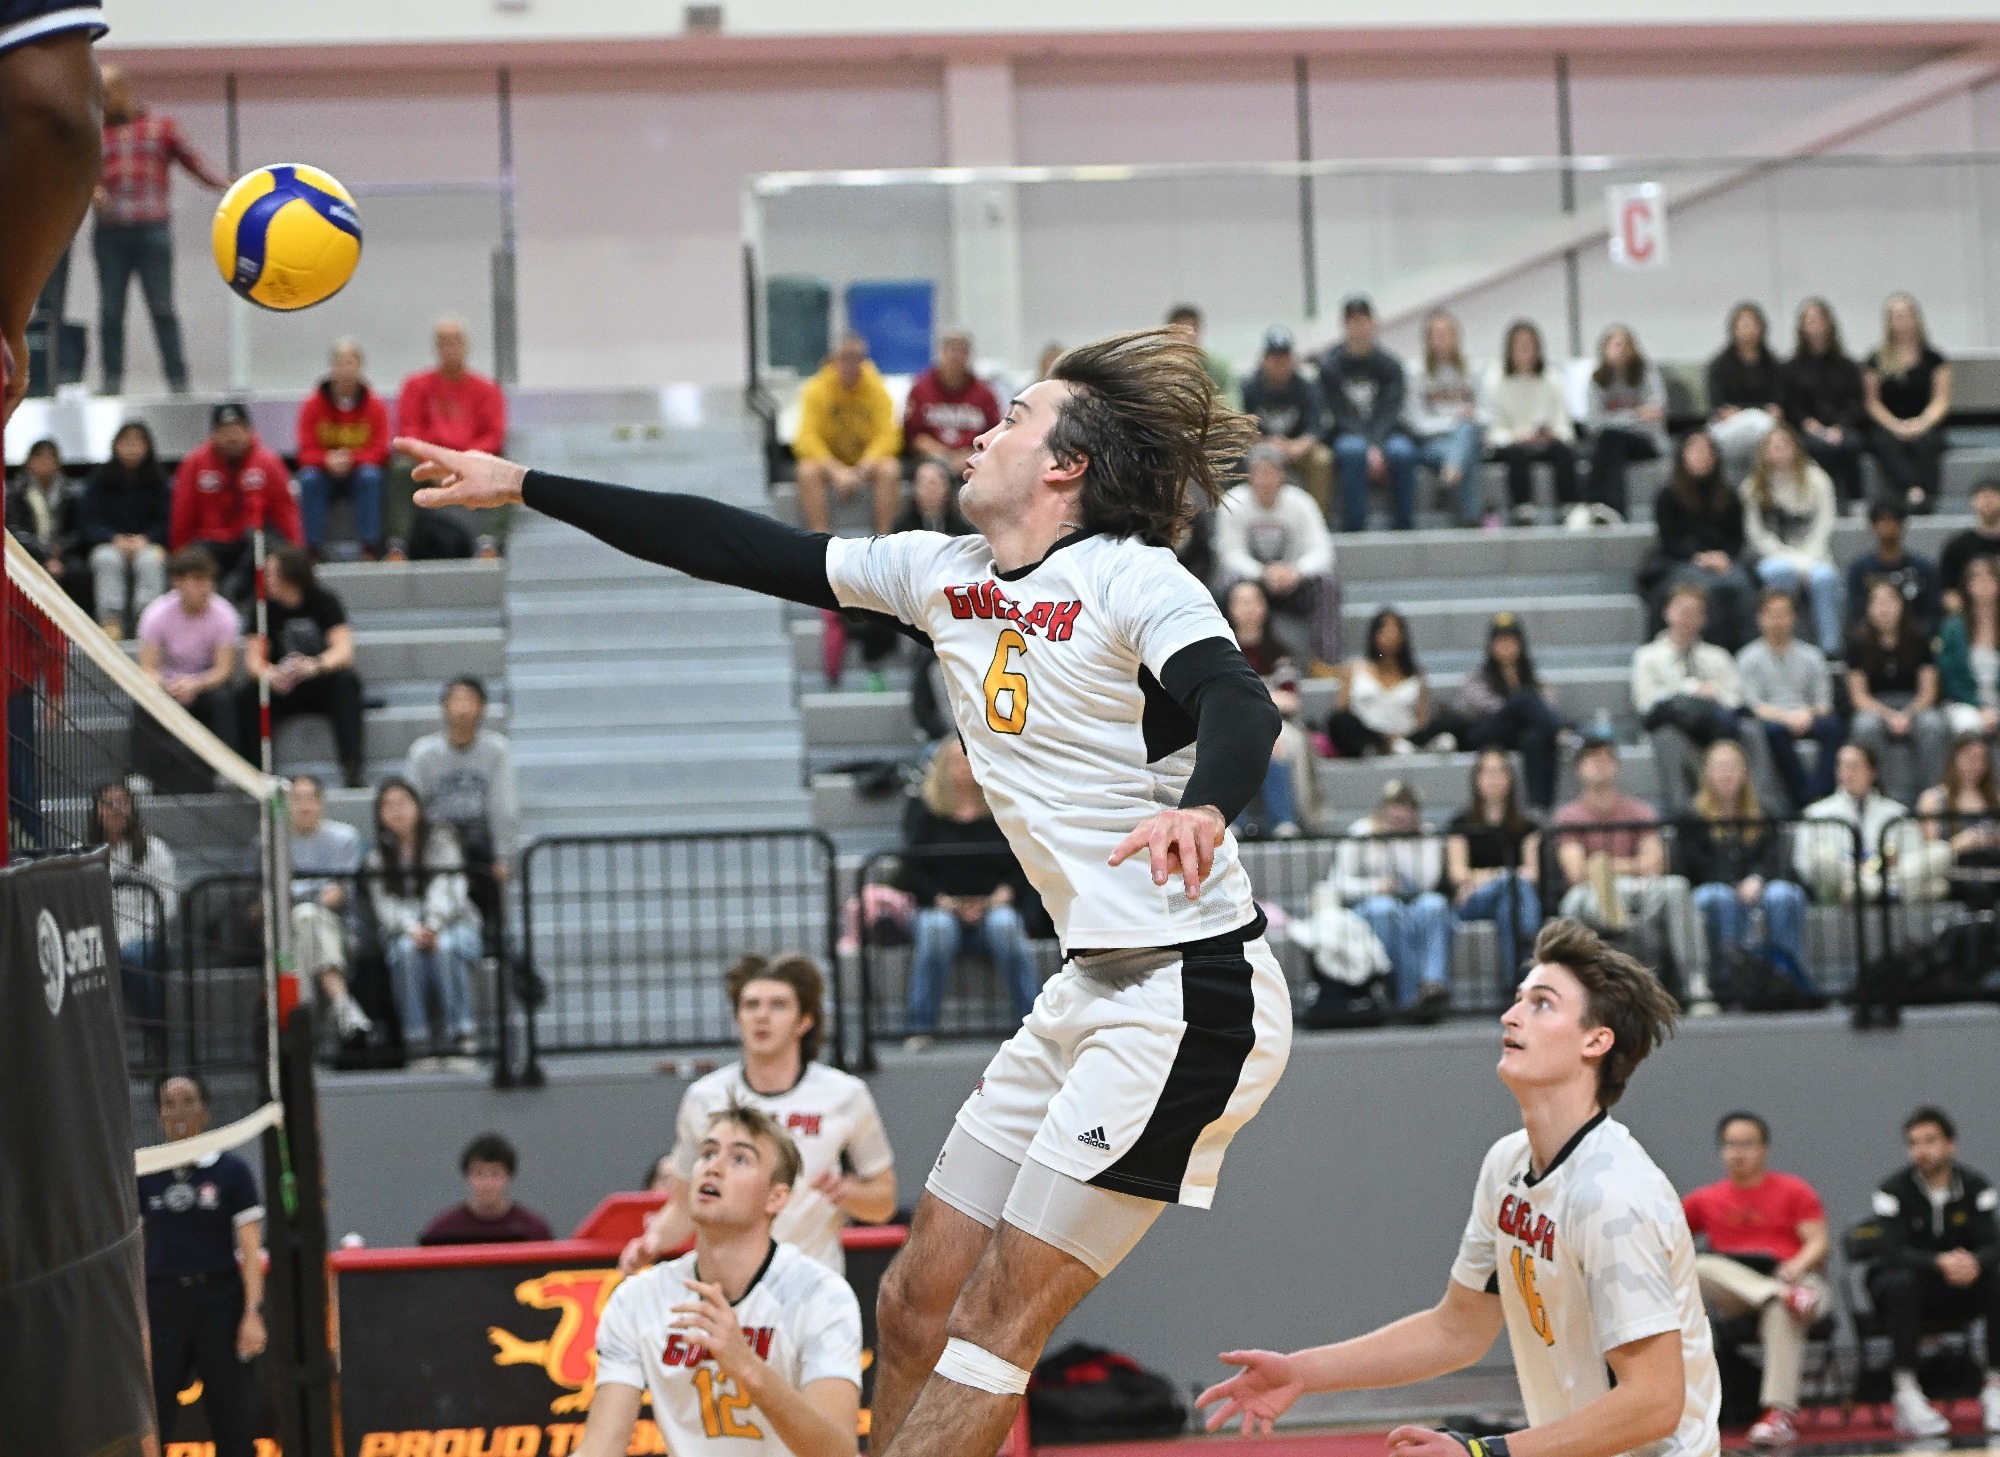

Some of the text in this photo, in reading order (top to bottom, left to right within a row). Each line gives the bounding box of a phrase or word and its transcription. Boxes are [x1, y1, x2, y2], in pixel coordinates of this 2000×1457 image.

[1622, 199, 1655, 262] C
[983, 628, 1029, 735] 6
[1077, 1134, 1110, 1150] adidas
[1511, 1245, 1556, 1346] 16
[691, 1366, 765, 1439] 12
[358, 1424, 543, 1457] PROUD
